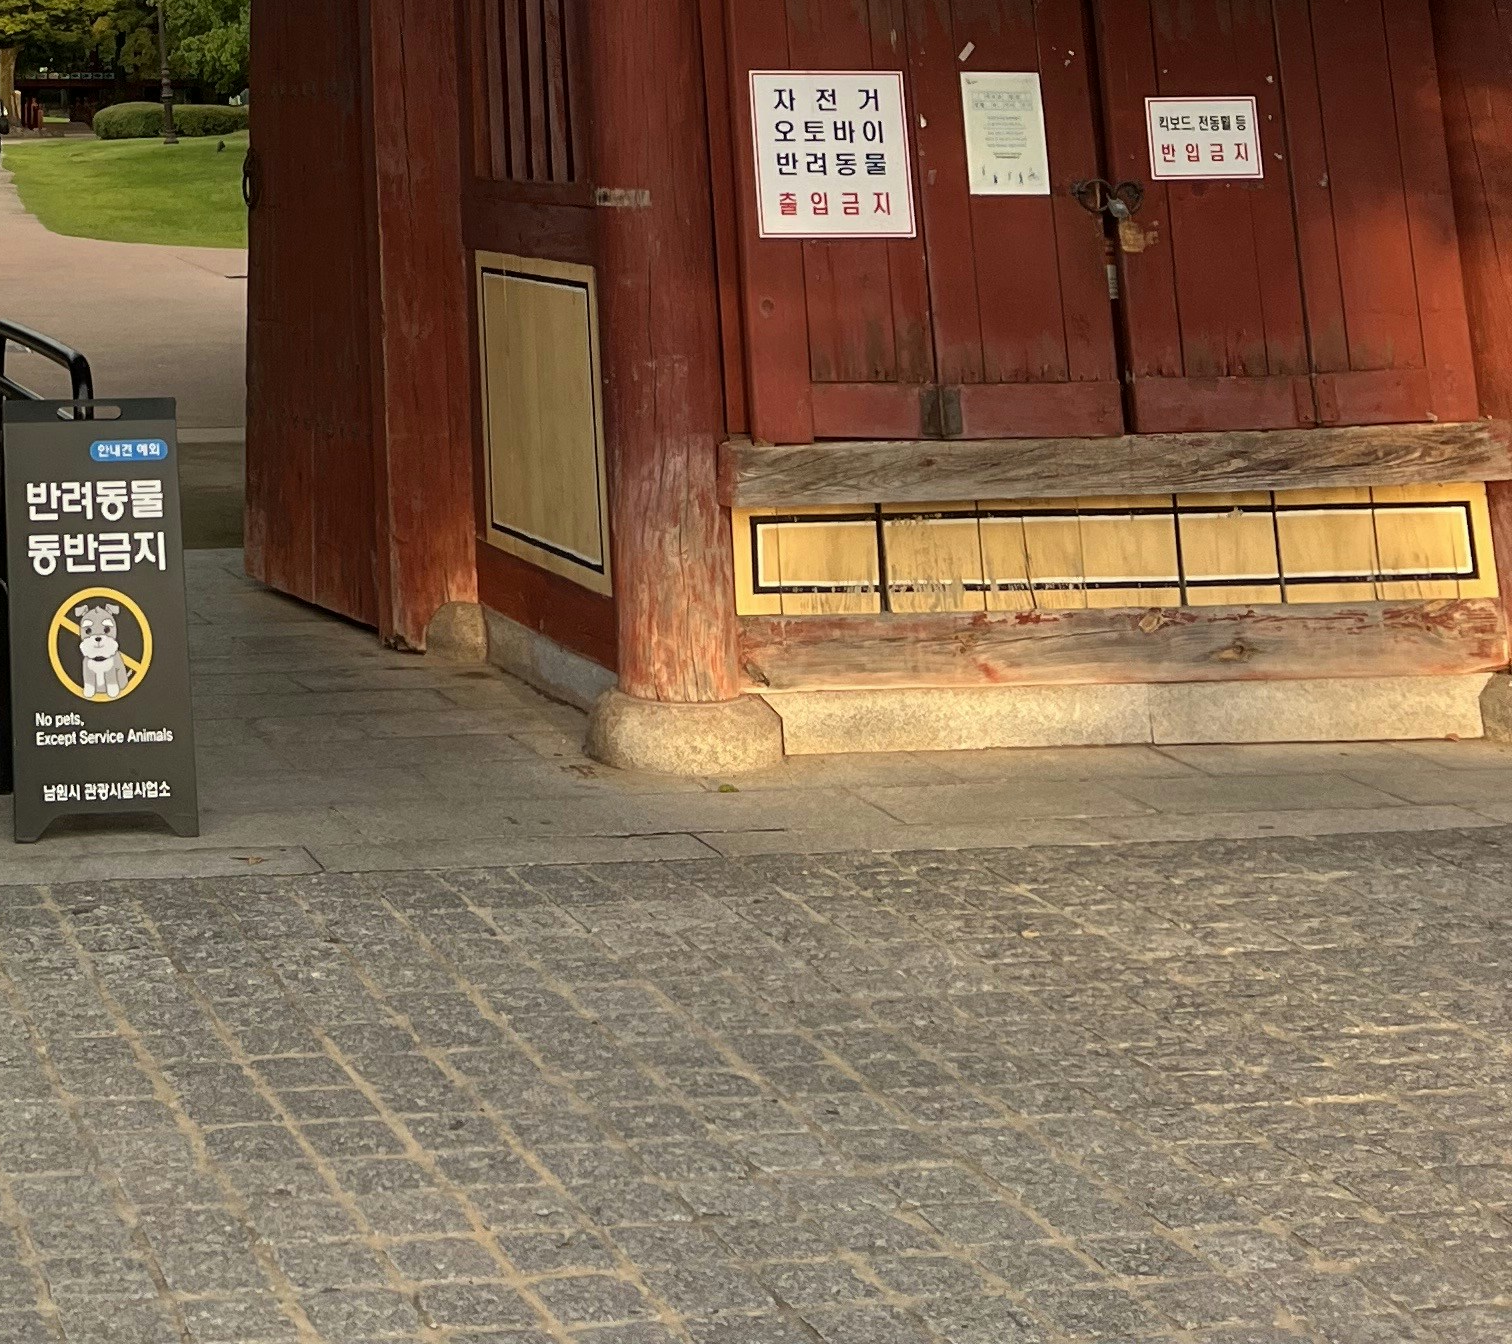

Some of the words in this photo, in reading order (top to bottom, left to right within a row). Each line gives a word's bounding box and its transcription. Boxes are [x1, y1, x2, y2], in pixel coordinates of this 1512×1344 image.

[774, 120, 884, 144] 오토바이
[1235, 115, 1247, 132] 등
[776, 152, 887, 177] 반려동물
[97, 443, 133, 458] 안내견
[25, 479, 164, 522] 반려동물
[27, 531, 167, 576] 동반금지
[35, 712, 53, 727] No
[36, 730, 77, 747] Except
[79, 729, 125, 745] Service
[127, 728, 174, 743] Animals
[43, 784, 81, 802] 남원시
[84, 780, 171, 801] 관광시설사업소
